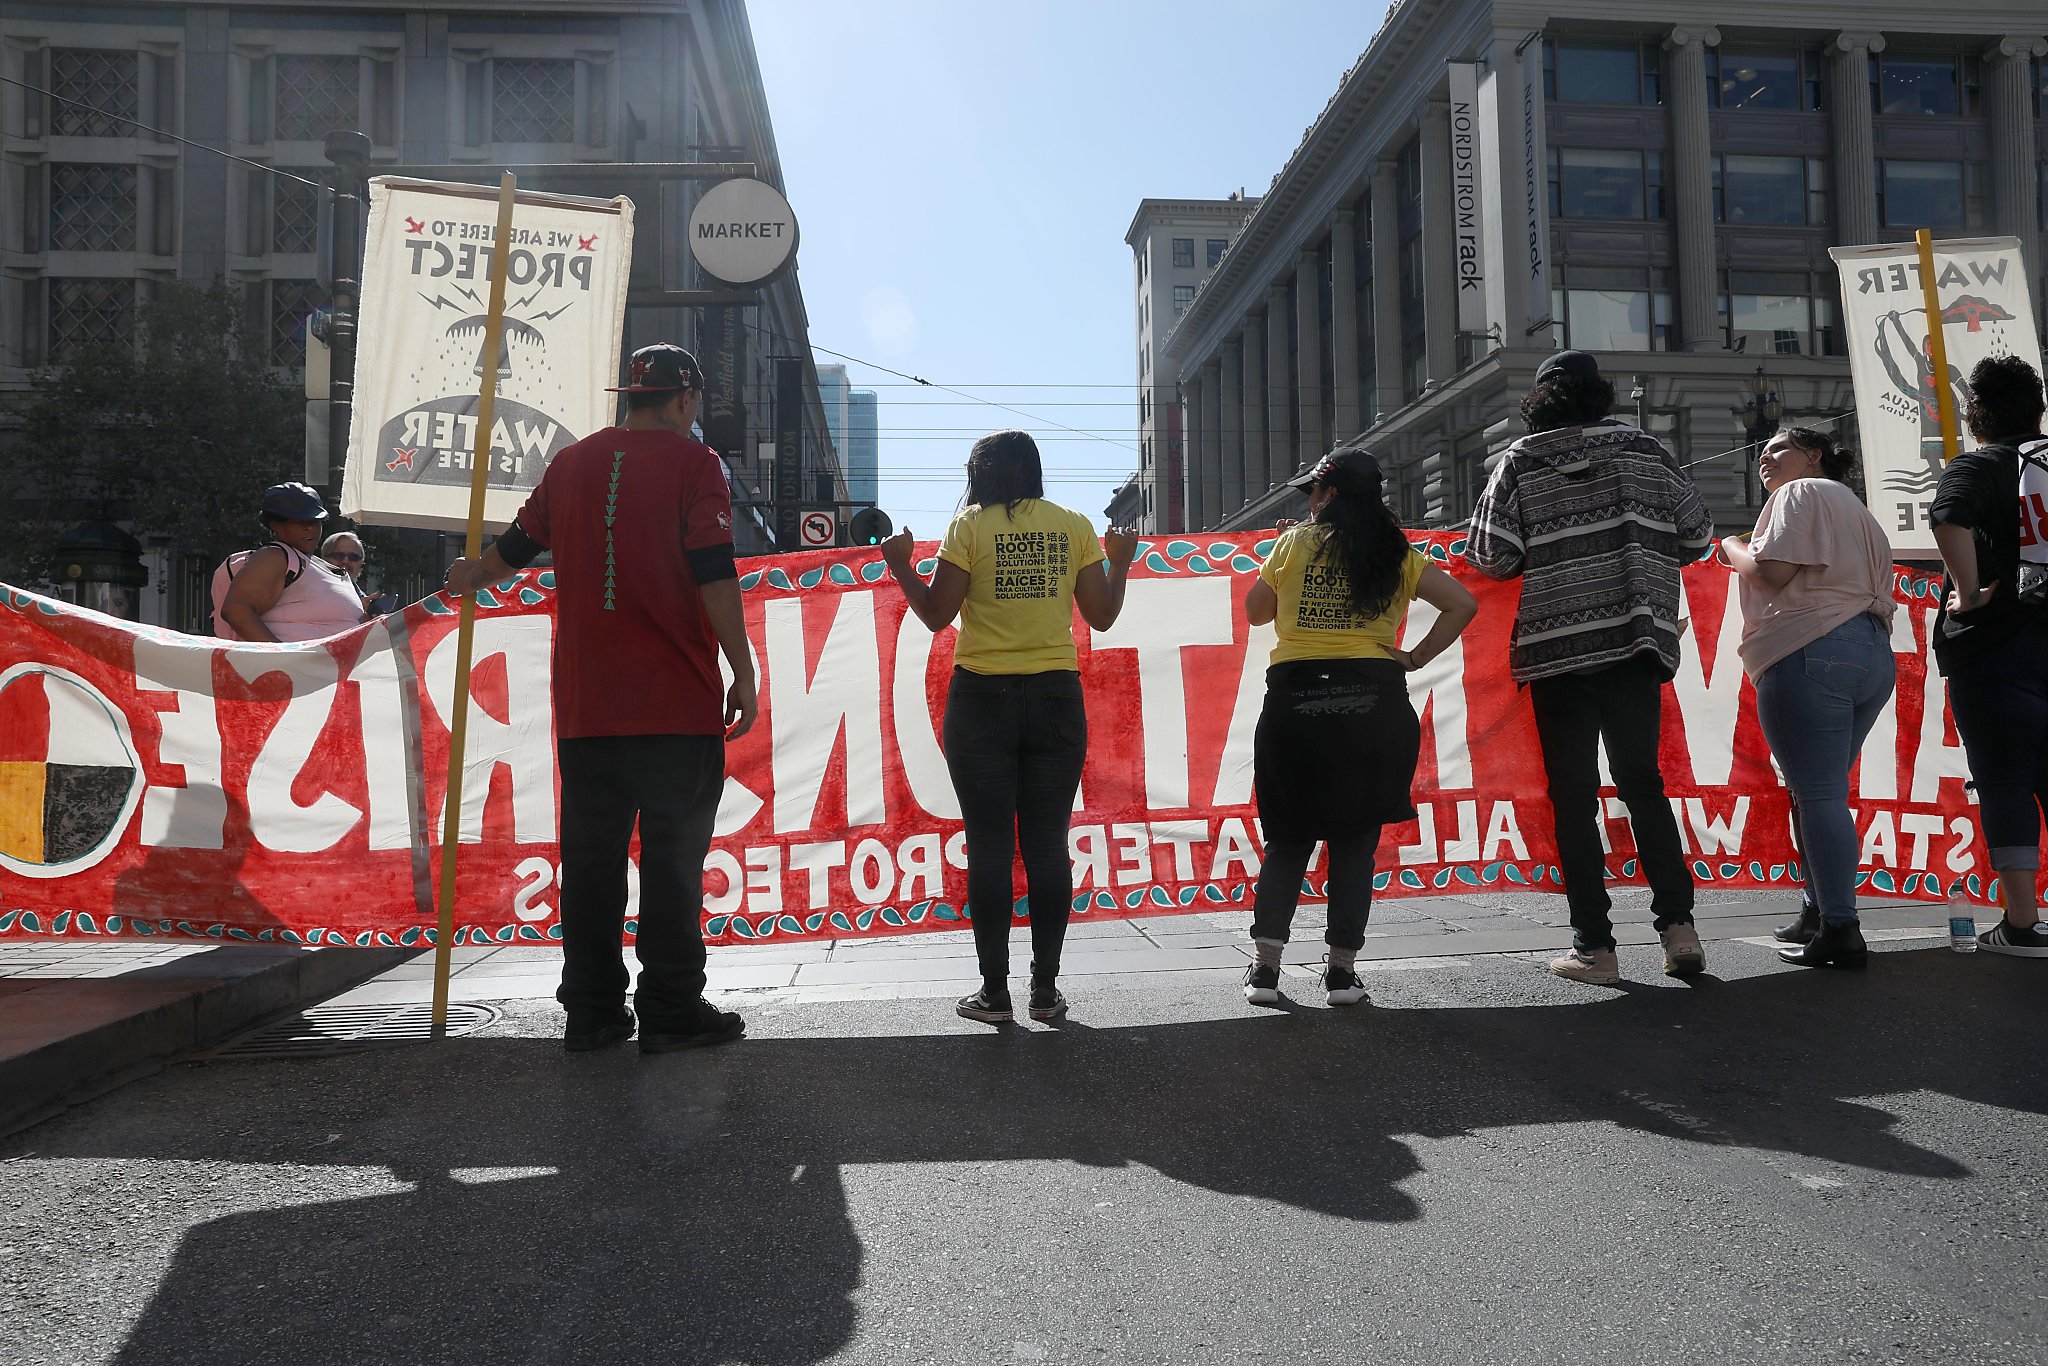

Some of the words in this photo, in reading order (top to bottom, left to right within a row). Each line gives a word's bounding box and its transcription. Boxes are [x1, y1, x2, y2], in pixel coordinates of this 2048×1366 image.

[1524, 83, 1536, 216] NORDSTROM
[1454, 102, 1475, 228] NORDSTROM
[698, 222, 785, 239] MARKET
[1529, 221, 1543, 281] rack
[1460, 235, 1483, 291] rack
[711, 352, 735, 420] Westfield
[994, 533, 1004, 542] IT
[1007, 532, 1044, 541] TAKES
[995, 541, 1045, 554] ROOTS
[1007, 552, 1045, 560] CULTIVATE
[995, 559, 1046, 567] SOLUTIONS
[1305, 564, 1316, 574] IT
[995, 575, 1046, 586] RAÍCES
[1296, 621, 1352, 630] SOLUCIONES
[1307, 688, 1328, 696] FANG
